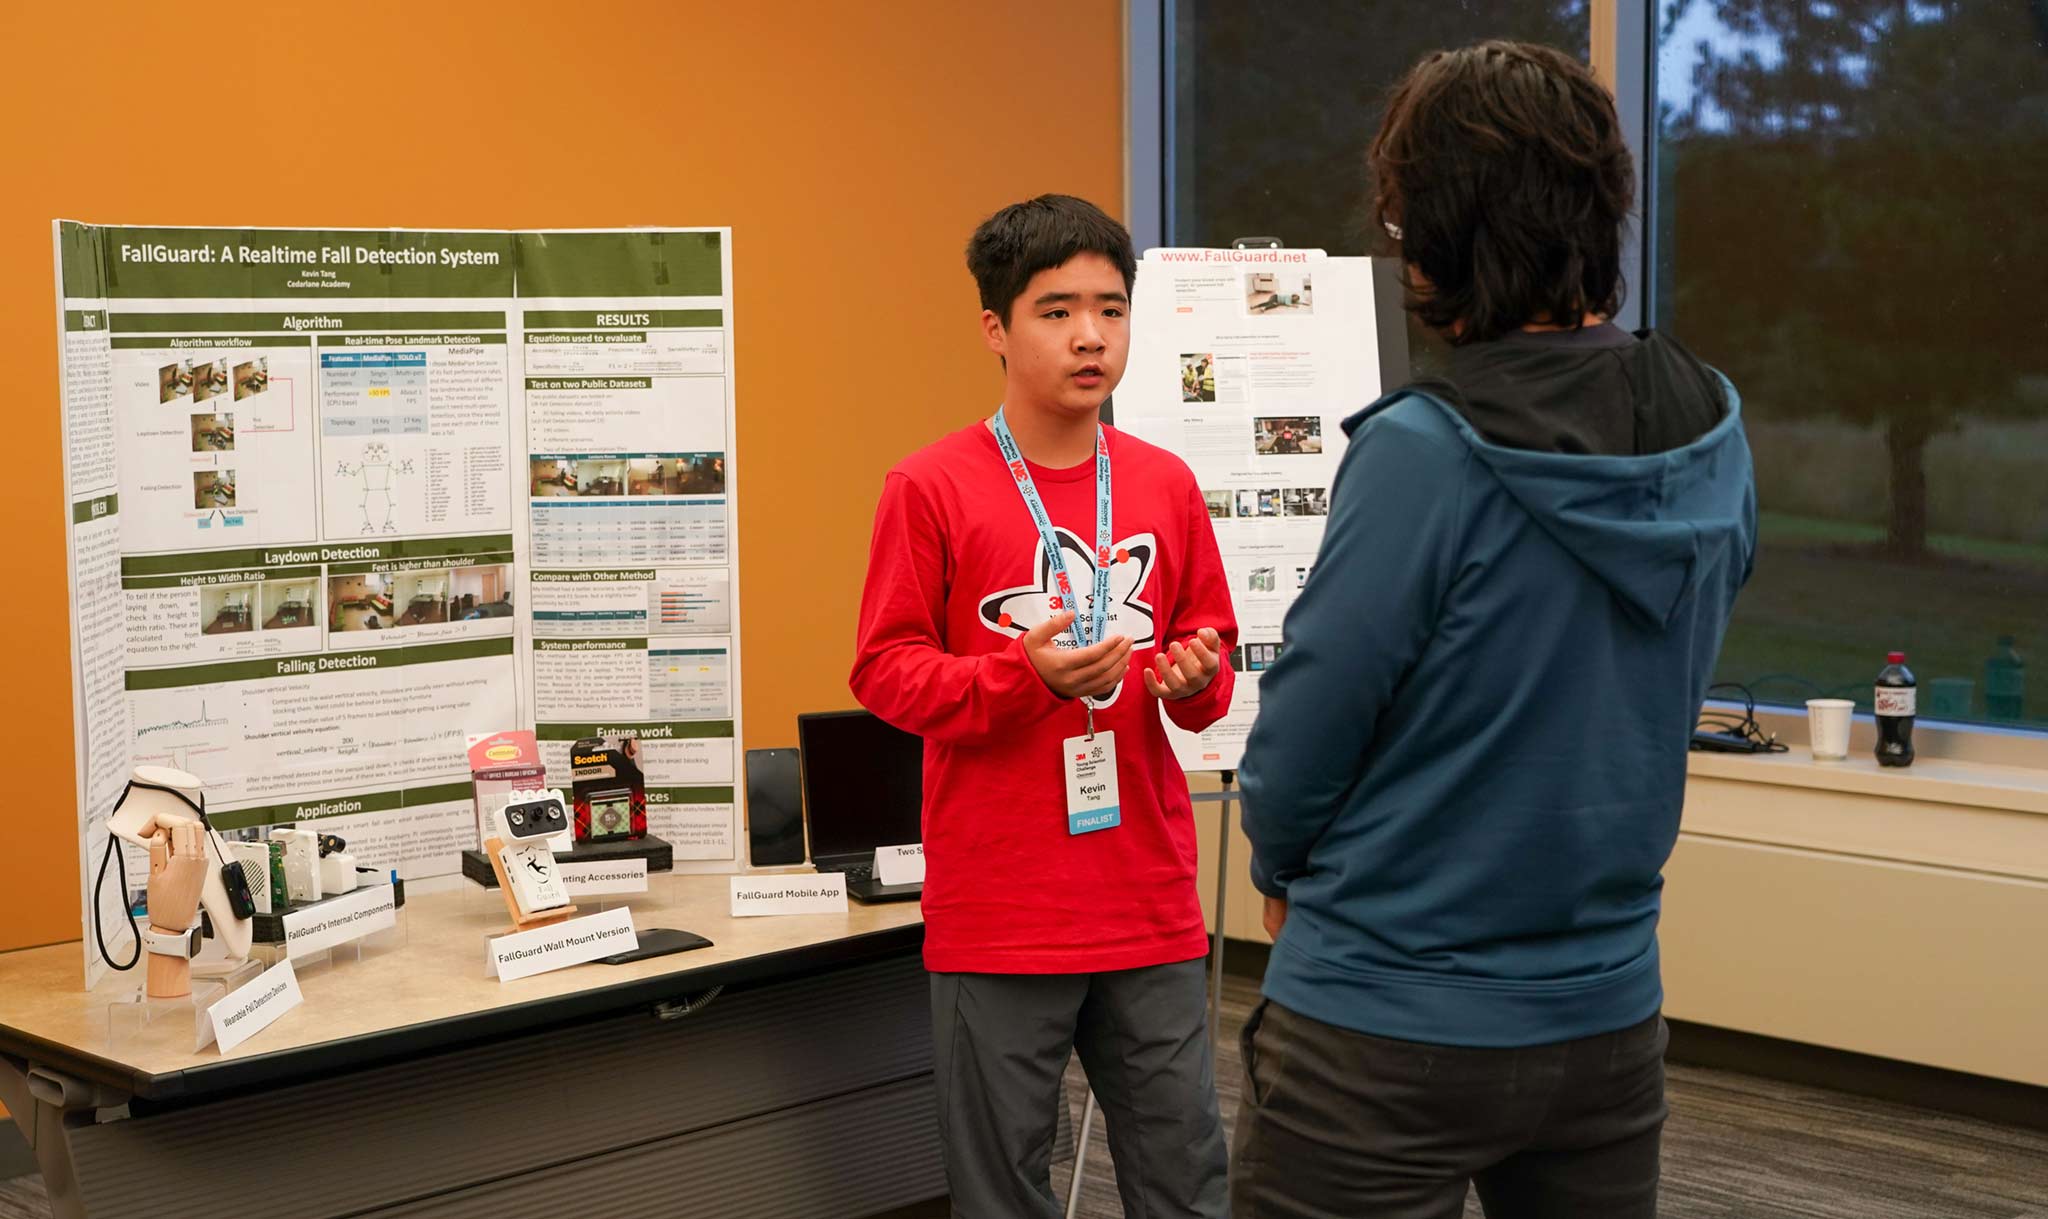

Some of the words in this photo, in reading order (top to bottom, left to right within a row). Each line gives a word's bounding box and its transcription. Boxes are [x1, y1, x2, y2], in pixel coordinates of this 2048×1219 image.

[121, 244, 216, 264] FallGuard:
[220, 246, 234, 263] A
[239, 245, 316, 264] Realtime
[322, 246, 351, 264] Fall
[356, 247, 437, 265] Detection
[441, 248, 500, 268] System
[1161, 250, 1307, 264] www.FallGuard.net
[301, 270, 319, 278] Kevin
[320, 270, 336, 279] Tang
[321, 280, 351, 289] Academy
[283, 315, 343, 332] Algorithm
[596, 314, 650, 326] RESULTS
[170, 339, 213, 348] Algorithm
[214, 338, 252, 347] workflow
[345, 337, 383, 346] Real-time
[385, 337, 402, 345] Pose
[404, 336, 443, 345] Landmark
[445, 335, 481, 344] Detection
[528, 334, 570, 344] Equations
[572, 334, 592, 343] used
[594, 334, 604, 343] to
[605, 333, 642, 342] evaluate
[448, 347, 485, 356] MediaPipe
[530, 380, 549, 389] Test
[550, 381, 561, 389] on
[563, 380, 579, 389] two
[581, 379, 608, 388] Public
[609, 379, 647, 388] Datasets
[1010, 460, 1028, 483] 3M
[265, 550, 318, 566] Laydown
[321, 547, 380, 561] Detection
[1097, 545, 1110, 569] 3M
[372, 563, 389, 573] Feet
[391, 562, 398, 571] is
[400, 560, 422, 571] higher
[423, 559, 441, 569] than
[443, 557, 475, 567] shoulder
[181, 574, 206, 586] Height
[208, 575, 217, 584] to
[218, 573, 242, 583] Width
[244, 571, 266, 582] Ratio
[533, 572, 571, 582] Compare
[572, 571, 591, 581] with
[593, 571, 619, 581] Other
[622, 571, 654, 581] Method
[1057, 571, 1071, 595] 3M
[136, 592, 148, 600] tell
[170, 591, 191, 600] person
[125, 603, 147, 612] laying
[1049, 596, 1063, 609] 3
[126, 614, 146, 622] check
[167, 612, 187, 620] height
[1080, 613, 1117, 622] Sciist
[126, 624, 147, 632] width
[169, 622, 188, 630] These
[126, 634, 163, 642] calculated
[126, 645, 159, 654] equation
[169, 643, 180, 651] the
[541, 641, 570, 651] System
[572, 641, 627, 651] performance
[277, 659, 316, 674] Falling
[319, 655, 377, 670] Detection
[596, 727, 638, 738] Future
[641, 725, 673, 738] work
[574, 753, 608, 765] Scotch
[1076, 753, 1086, 761] 3M
[575, 767, 602, 777] INDOOR
[1080, 783, 1106, 795] Kevin
[1087, 794, 1101, 802] Tang
[295, 800, 362, 820] Application
[1077, 813, 1114, 828] FINALIST
[897, 847, 915, 856] Two
[588, 870, 645, 882] Accessories
[736, 889, 784, 900] FallGuard
[785, 888, 818, 899] Mobile
[820, 887, 840, 898] App
[288, 921, 328, 941] FallGuard's
[328, 913, 354, 929] Internal
[354, 901, 394, 921] Components
[498, 944, 543, 964] FallGuard
[543, 939, 565, 953] Wall
[566, 933, 595, 948] Mount
[596, 924, 631, 941] Version
[223, 1008, 247, 1028] Wearable
[245, 1003, 255, 1016] Fall
[253, 990, 273, 1010] Detection
[270, 981, 287, 999] Devices
